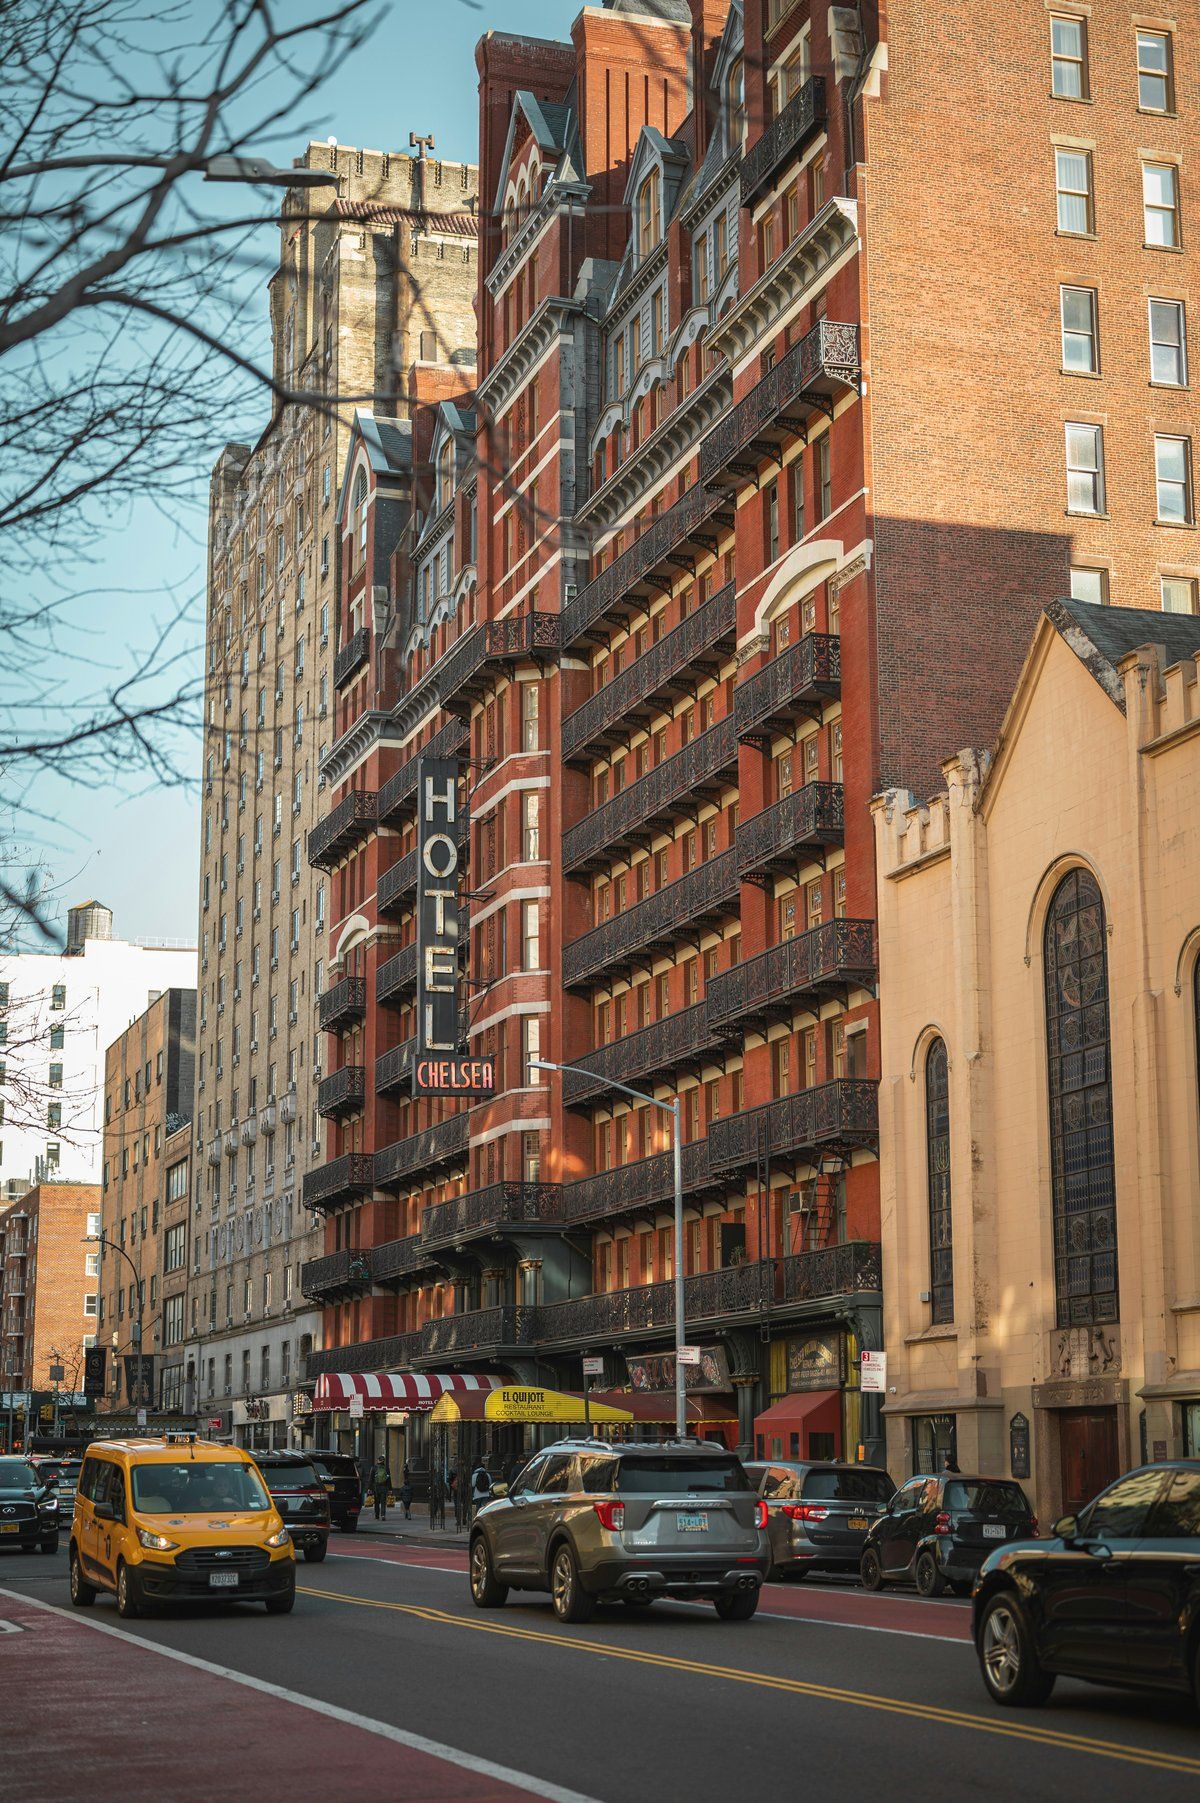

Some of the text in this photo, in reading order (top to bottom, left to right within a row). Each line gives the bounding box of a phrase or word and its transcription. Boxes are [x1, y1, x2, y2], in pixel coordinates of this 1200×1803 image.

[422, 776, 457, 1051] HOTEL
[417, 1061, 494, 1089] CHELSEA
[863, 1352, 869, 1361] 3
[502, 1391, 545, 1404] EL QUIJOTE
